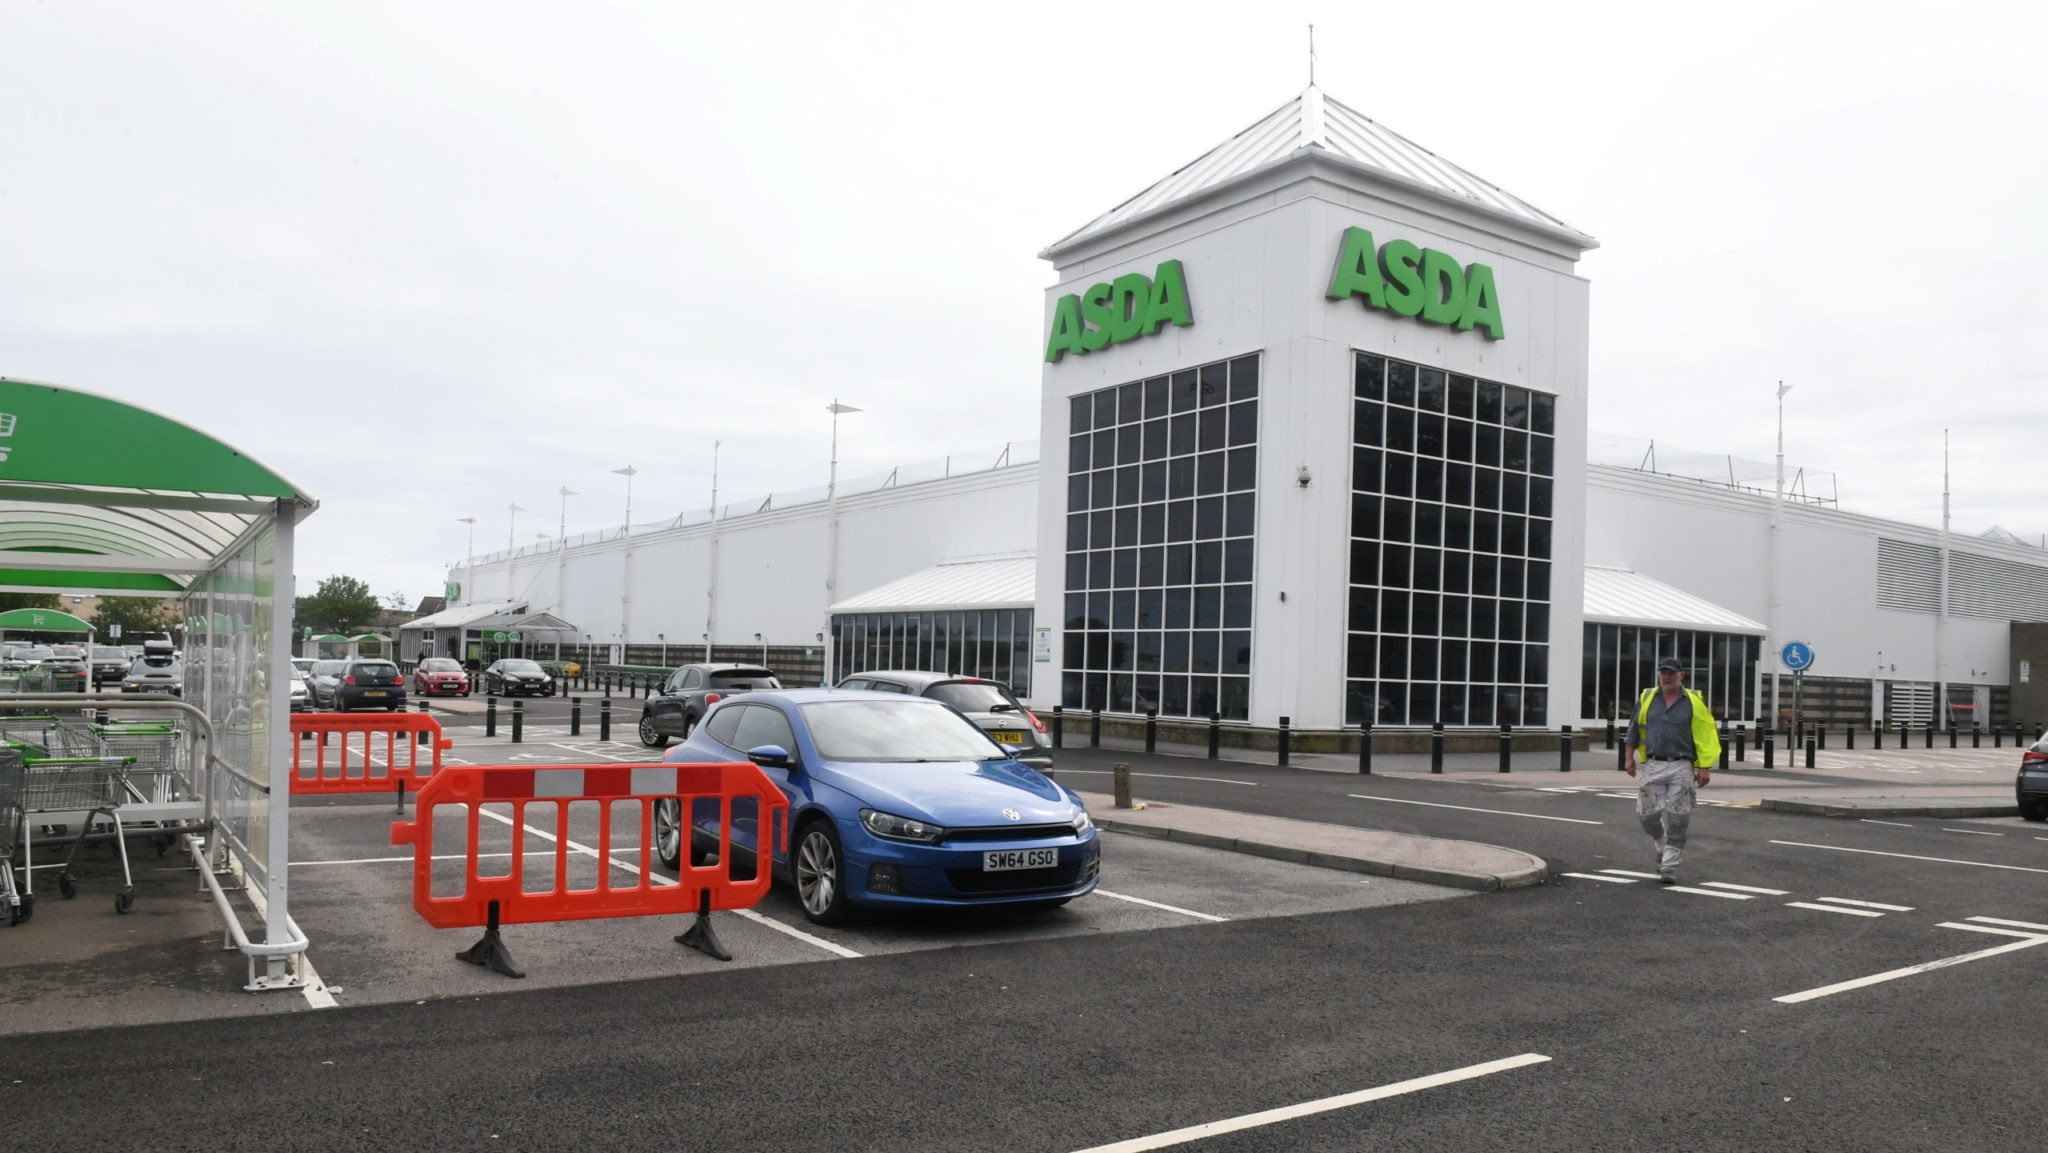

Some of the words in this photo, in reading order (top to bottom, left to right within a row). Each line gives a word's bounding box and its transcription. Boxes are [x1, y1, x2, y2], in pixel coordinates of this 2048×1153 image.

[1045, 258, 1195, 363] ASDA
[1325, 225, 1505, 341] ASDA
[989, 853, 1024, 868] SW64
[1028, 851, 1053, 866] GSO
